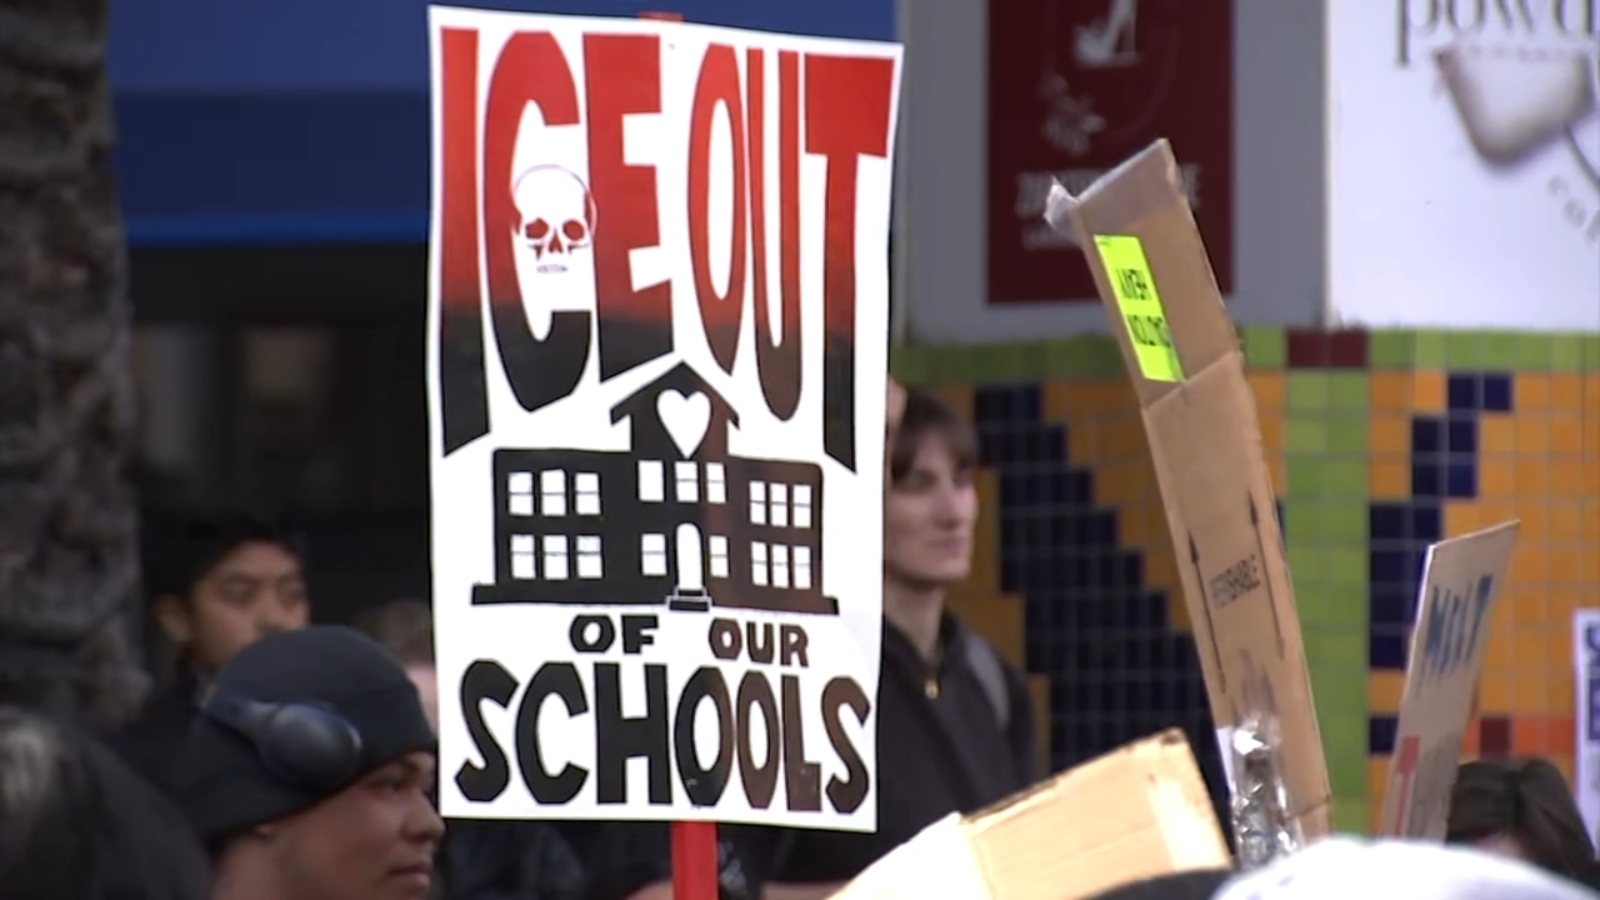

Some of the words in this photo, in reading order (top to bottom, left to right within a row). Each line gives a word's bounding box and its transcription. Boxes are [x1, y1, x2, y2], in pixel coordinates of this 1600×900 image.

[440, 26, 674, 458] ICE
[688, 42, 895, 475] OUT
[569, 614, 659, 654] OF
[708, 617, 809, 668] OUR
[454, 658, 871, 815] SCHOOLS
